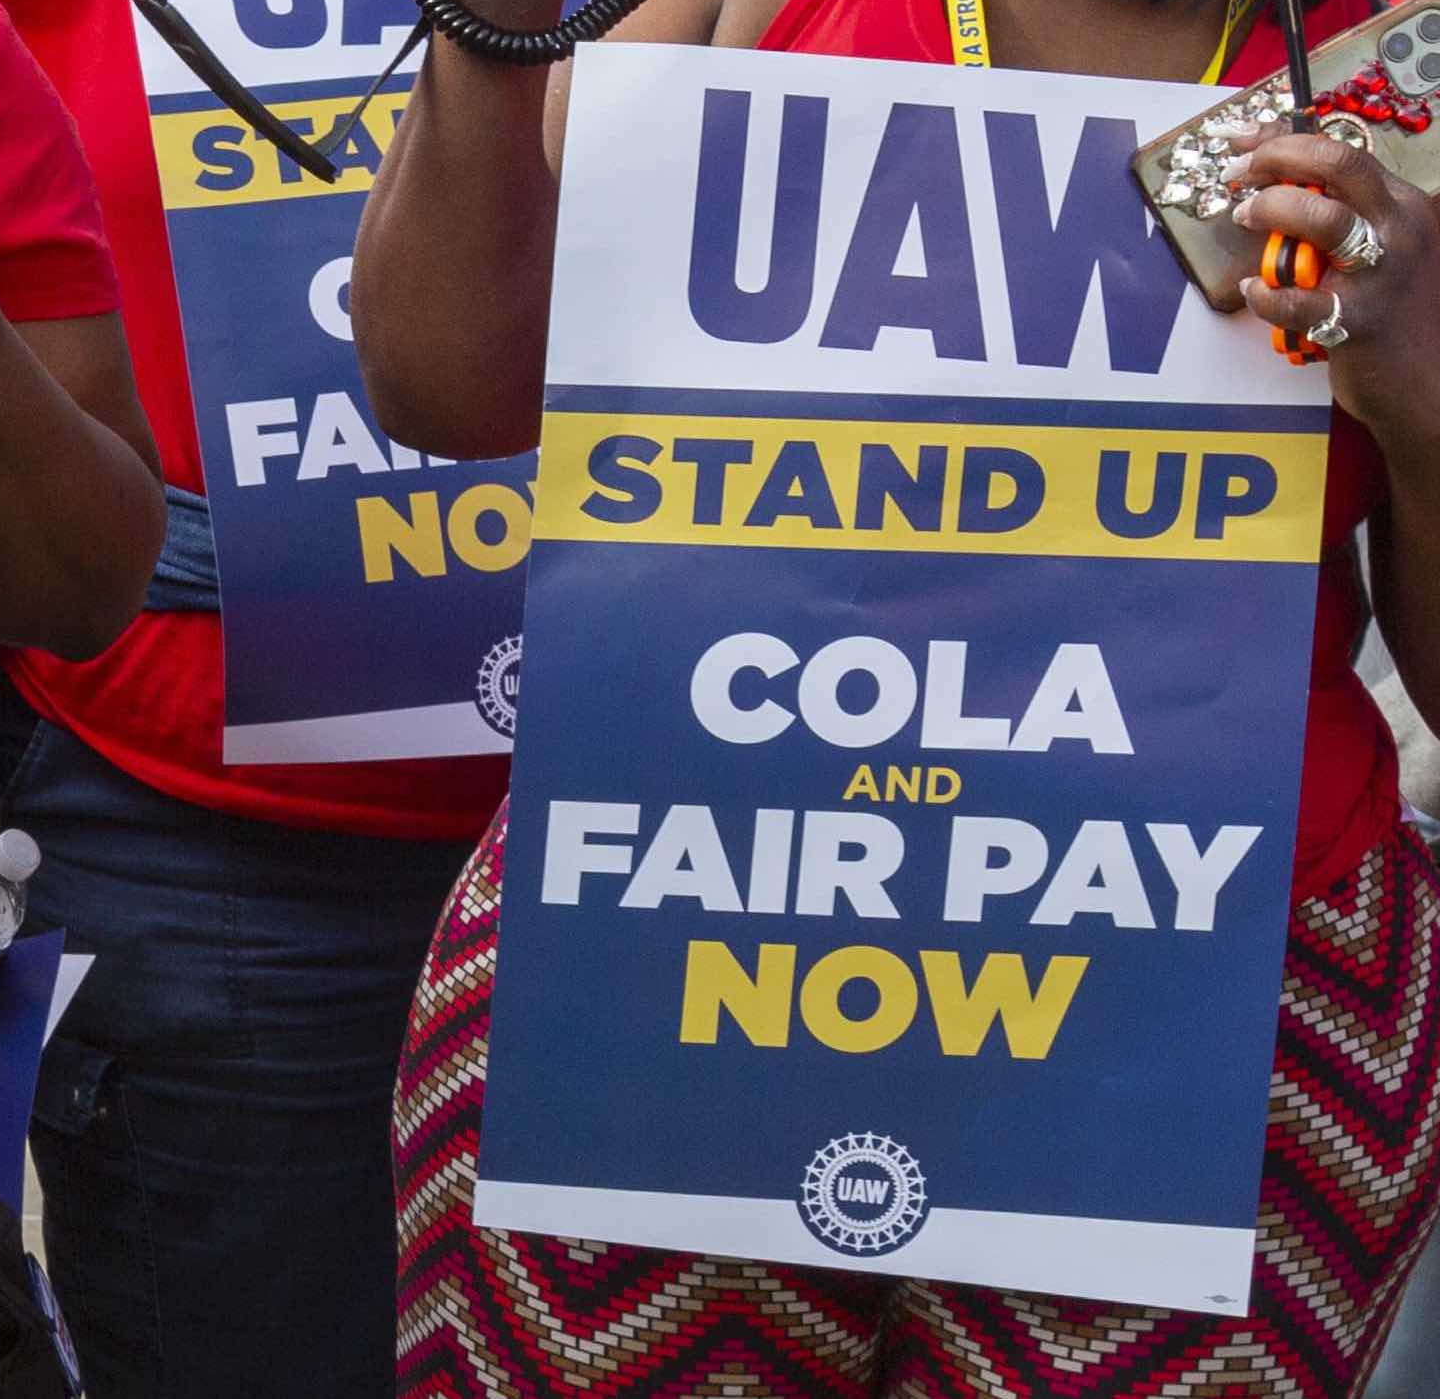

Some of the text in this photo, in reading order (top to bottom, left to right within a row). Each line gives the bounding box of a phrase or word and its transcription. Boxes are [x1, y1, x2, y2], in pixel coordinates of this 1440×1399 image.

[688, 89, 1195, 374] UAW
[584, 437, 1276, 538] STAND UP
[691, 633, 1134, 754] COLA
[843, 765, 961, 803] AND
[542, 801, 1262, 930] FAIR PAY
[681, 942, 1088, 1058] NOW
[836, 1176, 891, 1206] UAW
